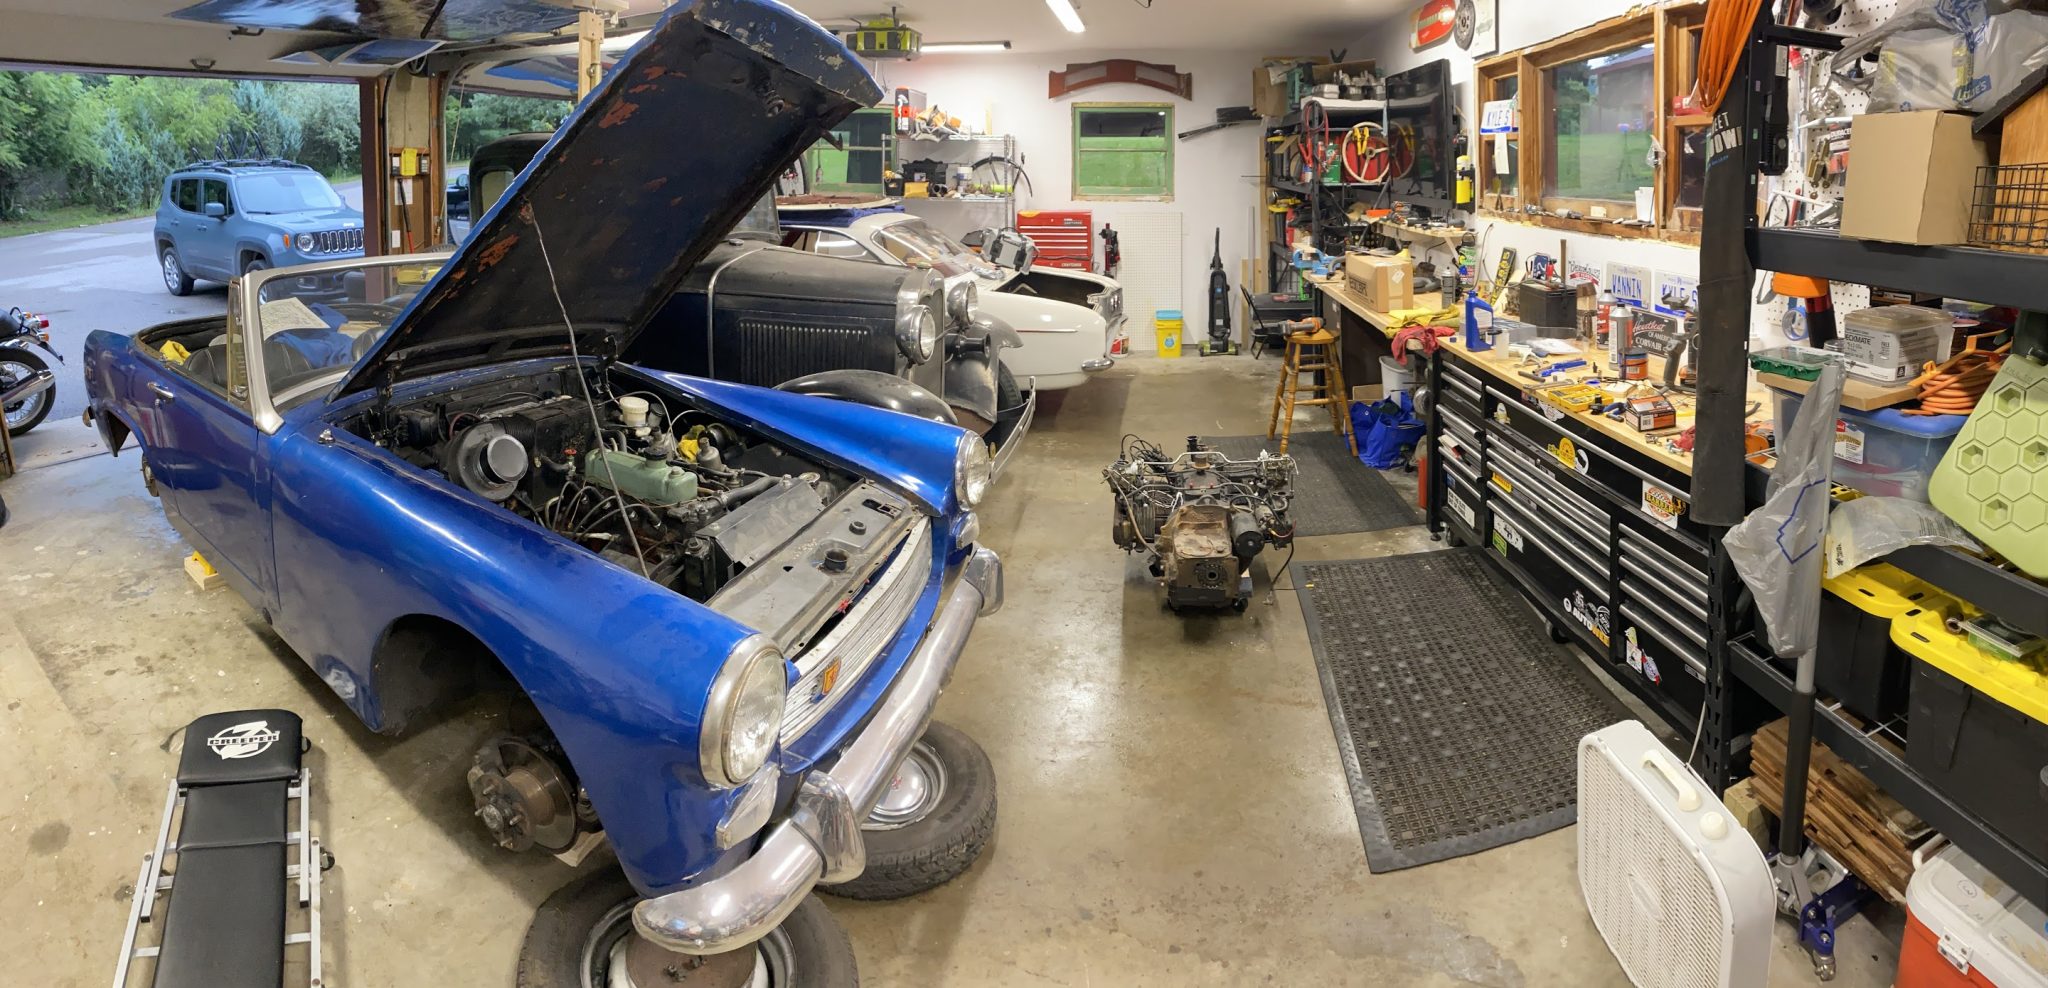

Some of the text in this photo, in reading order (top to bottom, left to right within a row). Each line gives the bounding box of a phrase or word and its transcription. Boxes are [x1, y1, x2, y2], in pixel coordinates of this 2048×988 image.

[1612, 273, 1642, 300] VANNIN
[1635, 337, 1663, 352] CORVAIR
[1845, 333, 1872, 346] ECKMATE
[209, 735, 279, 746] CREEPER
